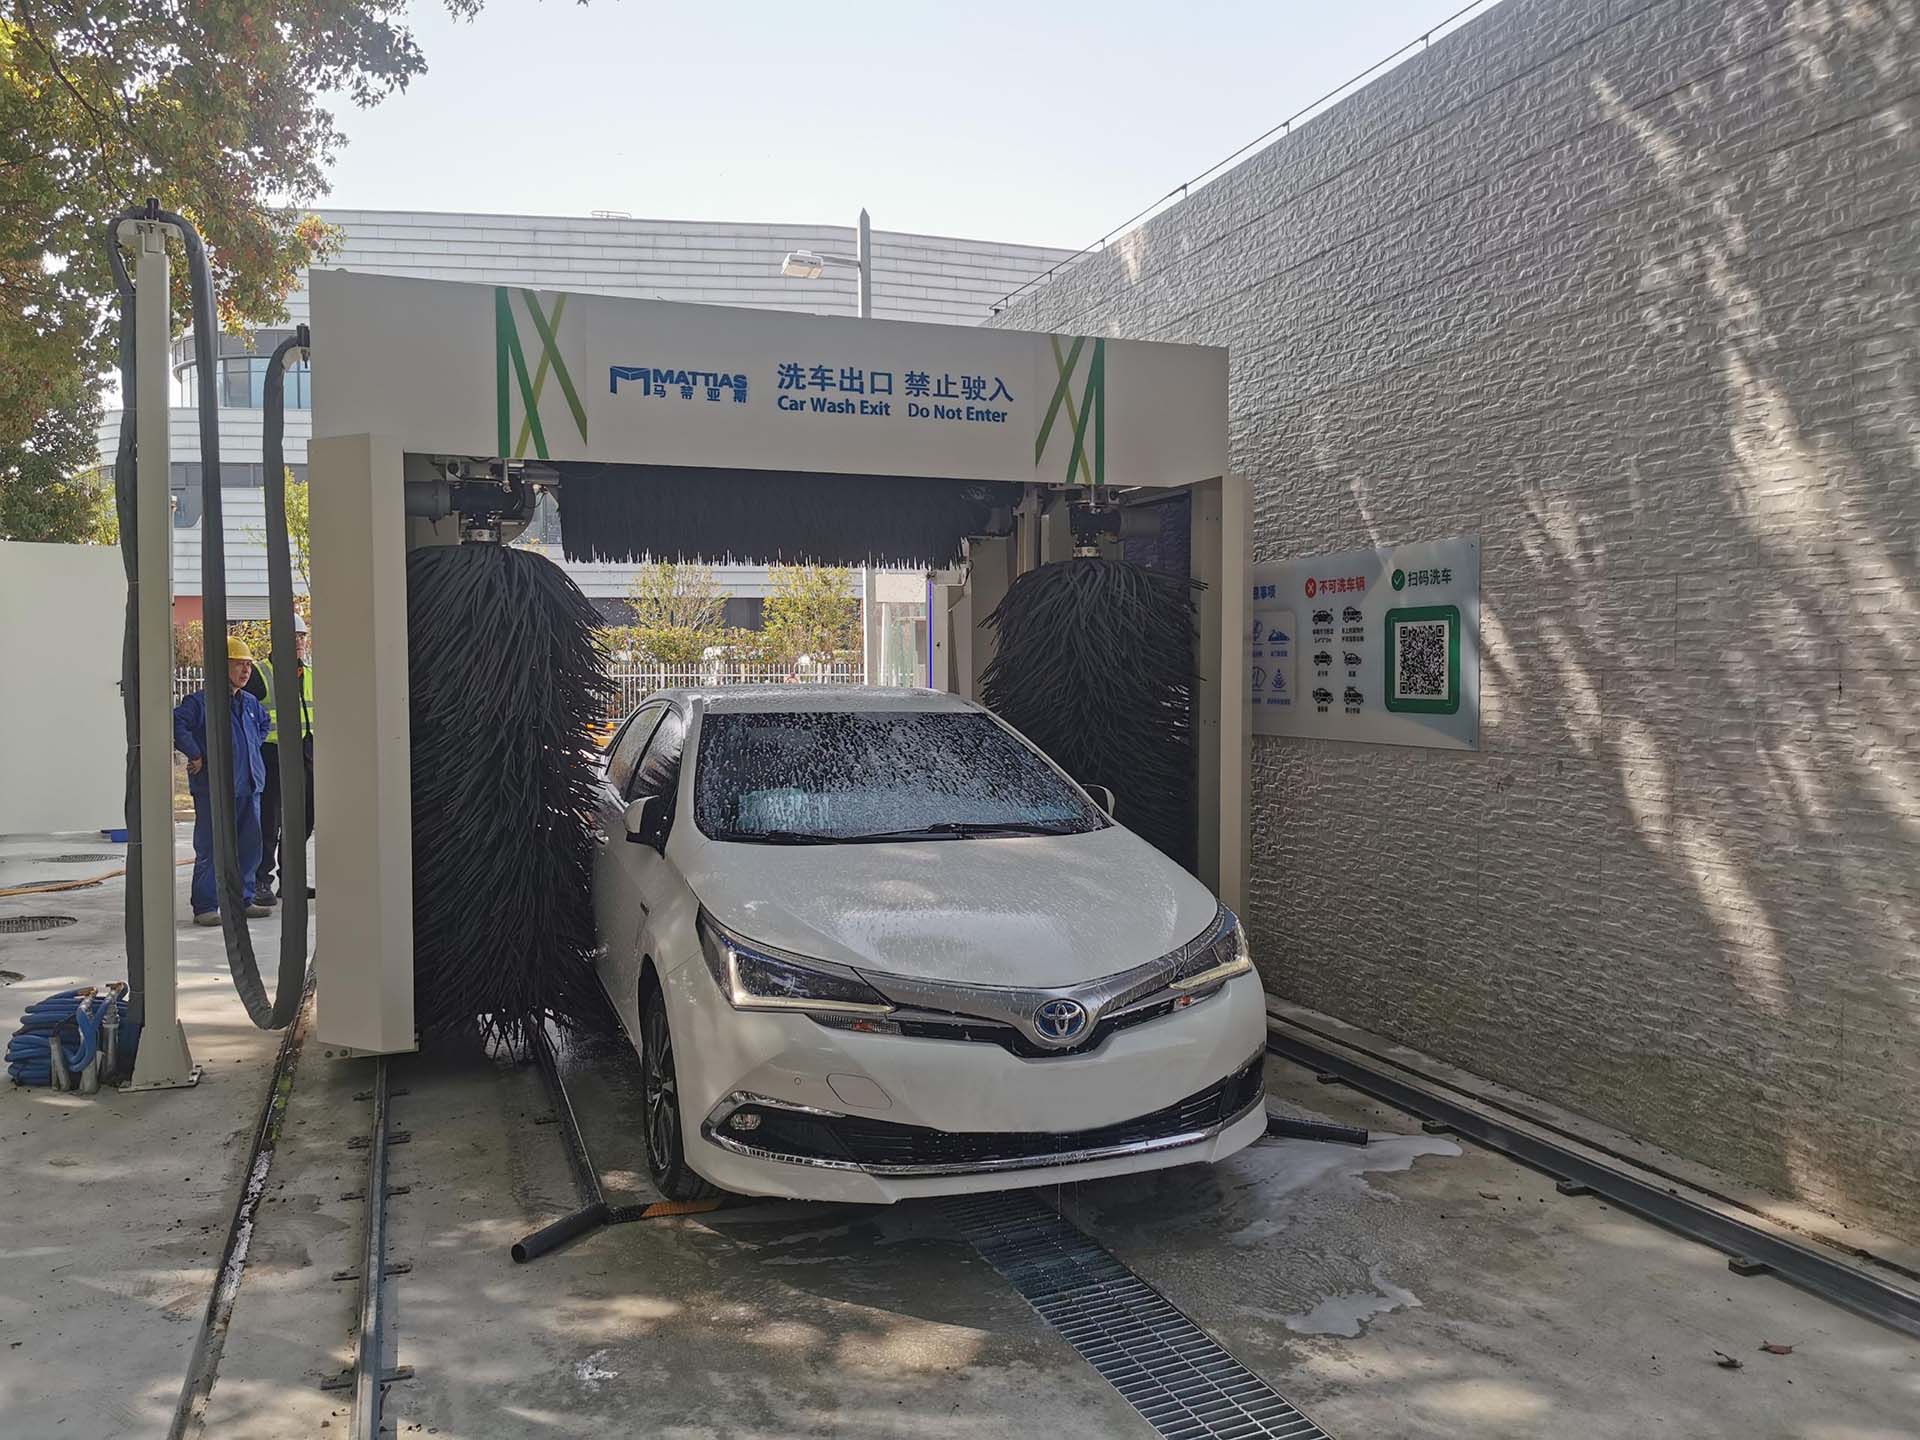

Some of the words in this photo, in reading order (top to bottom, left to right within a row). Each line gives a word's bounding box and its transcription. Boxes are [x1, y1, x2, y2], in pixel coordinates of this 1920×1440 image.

[652, 368, 748, 389] MATTIAS
[777, 363, 894, 395] 洗车出口
[904, 370, 1015, 403] 禁止驶入
[777, 395, 807, 411] Car
[810, 397, 855, 414] Wash
[860, 399, 891, 416] Exit
[908, 403, 930, 419] Do
[934, 405, 962, 421] Not
[966, 406, 1008, 423] Enter
[1319, 575, 1366, 595] 不可洗车辆
[1407, 568, 1453, 587] 扫码洗车
